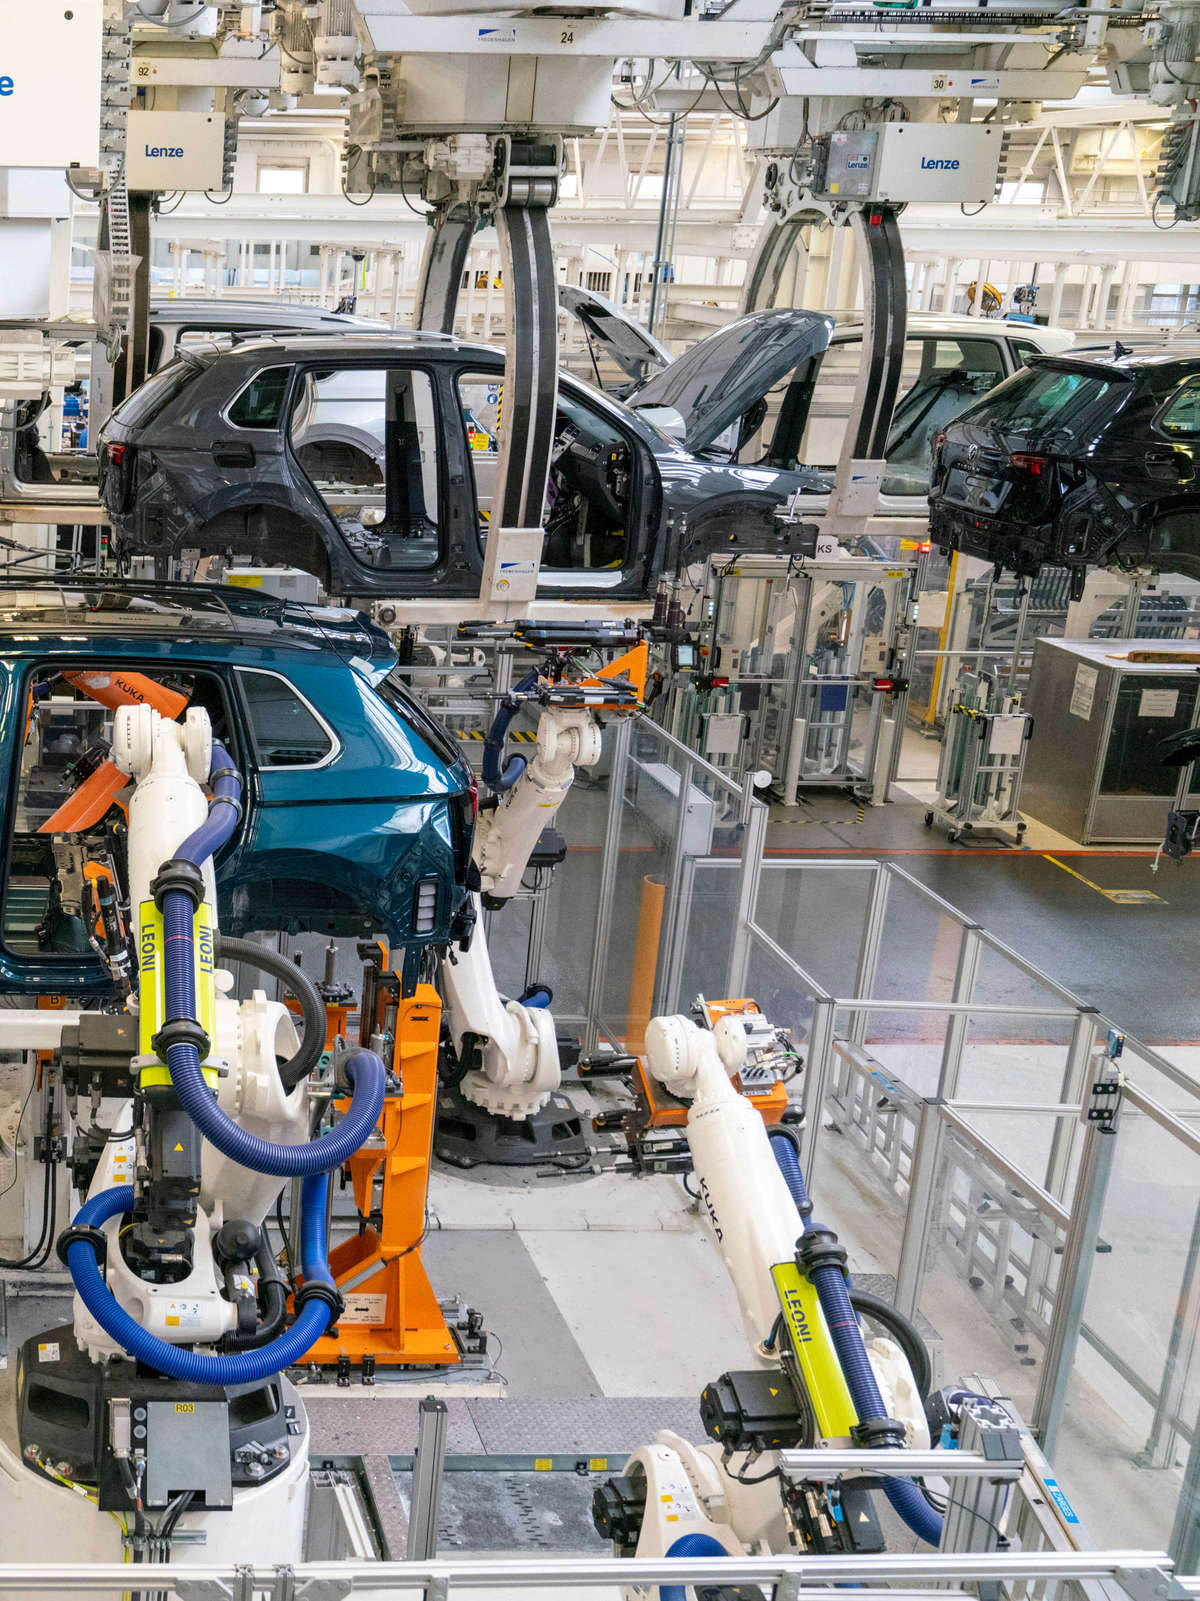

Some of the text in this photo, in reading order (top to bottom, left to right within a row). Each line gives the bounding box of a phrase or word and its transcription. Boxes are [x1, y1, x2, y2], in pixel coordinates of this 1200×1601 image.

[561, 32, 574, 44] 24
[138, 66, 150, 77] 92
[933, 79, 944, 89] 30
[145, 144, 184, 158] Lenze
[921, 156, 960, 171] Lenze
[115, 679, 144, 704] KUKA
[141, 924, 155, 972] LEONI
[199, 925, 213, 974] LEONI
[699, 1176, 723, 1244] KUKA
[784, 1288, 813, 1343] LEONI
[175, 1403, 194, 1413] R03
